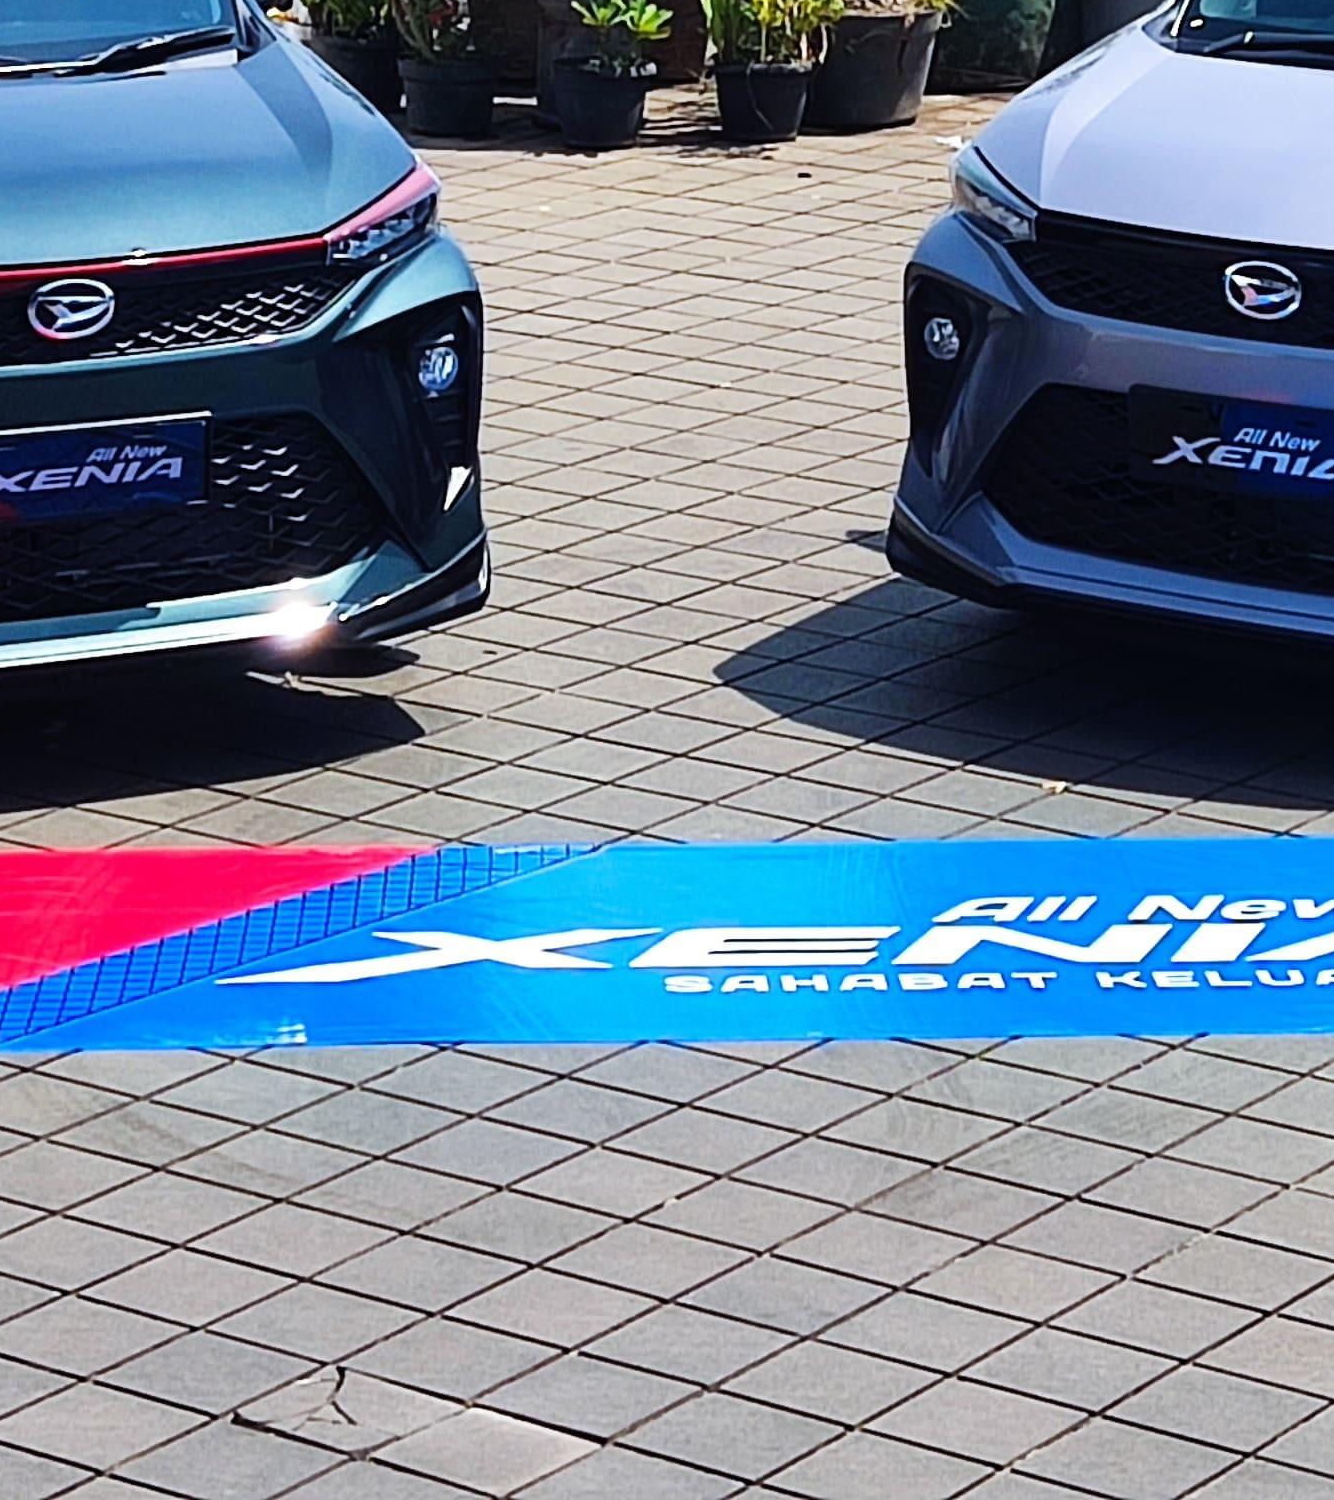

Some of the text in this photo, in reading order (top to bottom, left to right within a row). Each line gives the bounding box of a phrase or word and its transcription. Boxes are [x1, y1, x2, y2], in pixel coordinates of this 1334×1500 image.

[1233, 427, 1321, 452] All New
[86, 445, 167, 463] All New
[931, 895, 1098, 923] All
[664, 971, 1058, 993] SAHABAT
